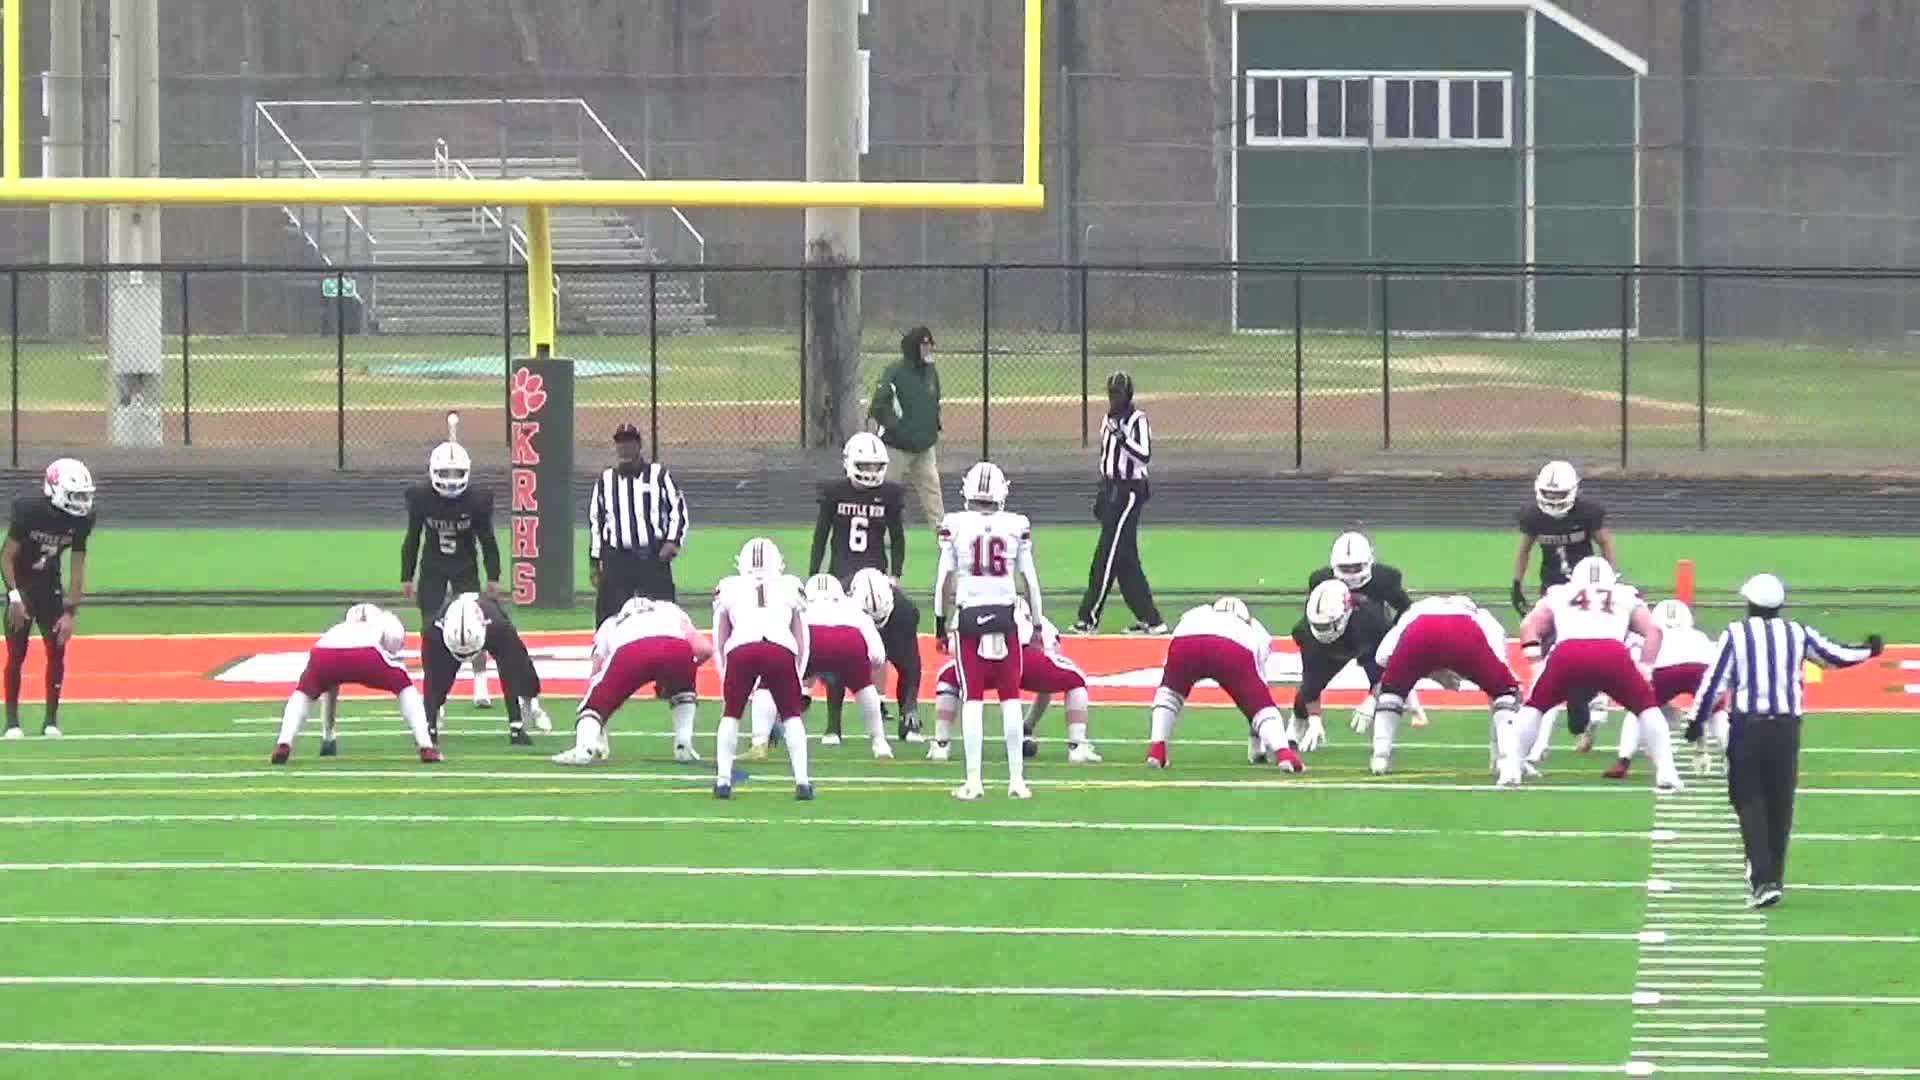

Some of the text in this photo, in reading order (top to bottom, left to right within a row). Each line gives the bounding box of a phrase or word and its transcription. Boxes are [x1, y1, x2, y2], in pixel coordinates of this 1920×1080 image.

[511, 422, 540, 605] KRHS
[438, 531, 457, 555] 5
[849, 516, 869, 552] 6
[968, 535, 1008, 577] 16
[754, 583, 768, 608] 1
[1568, 588, 1615, 615] 47
